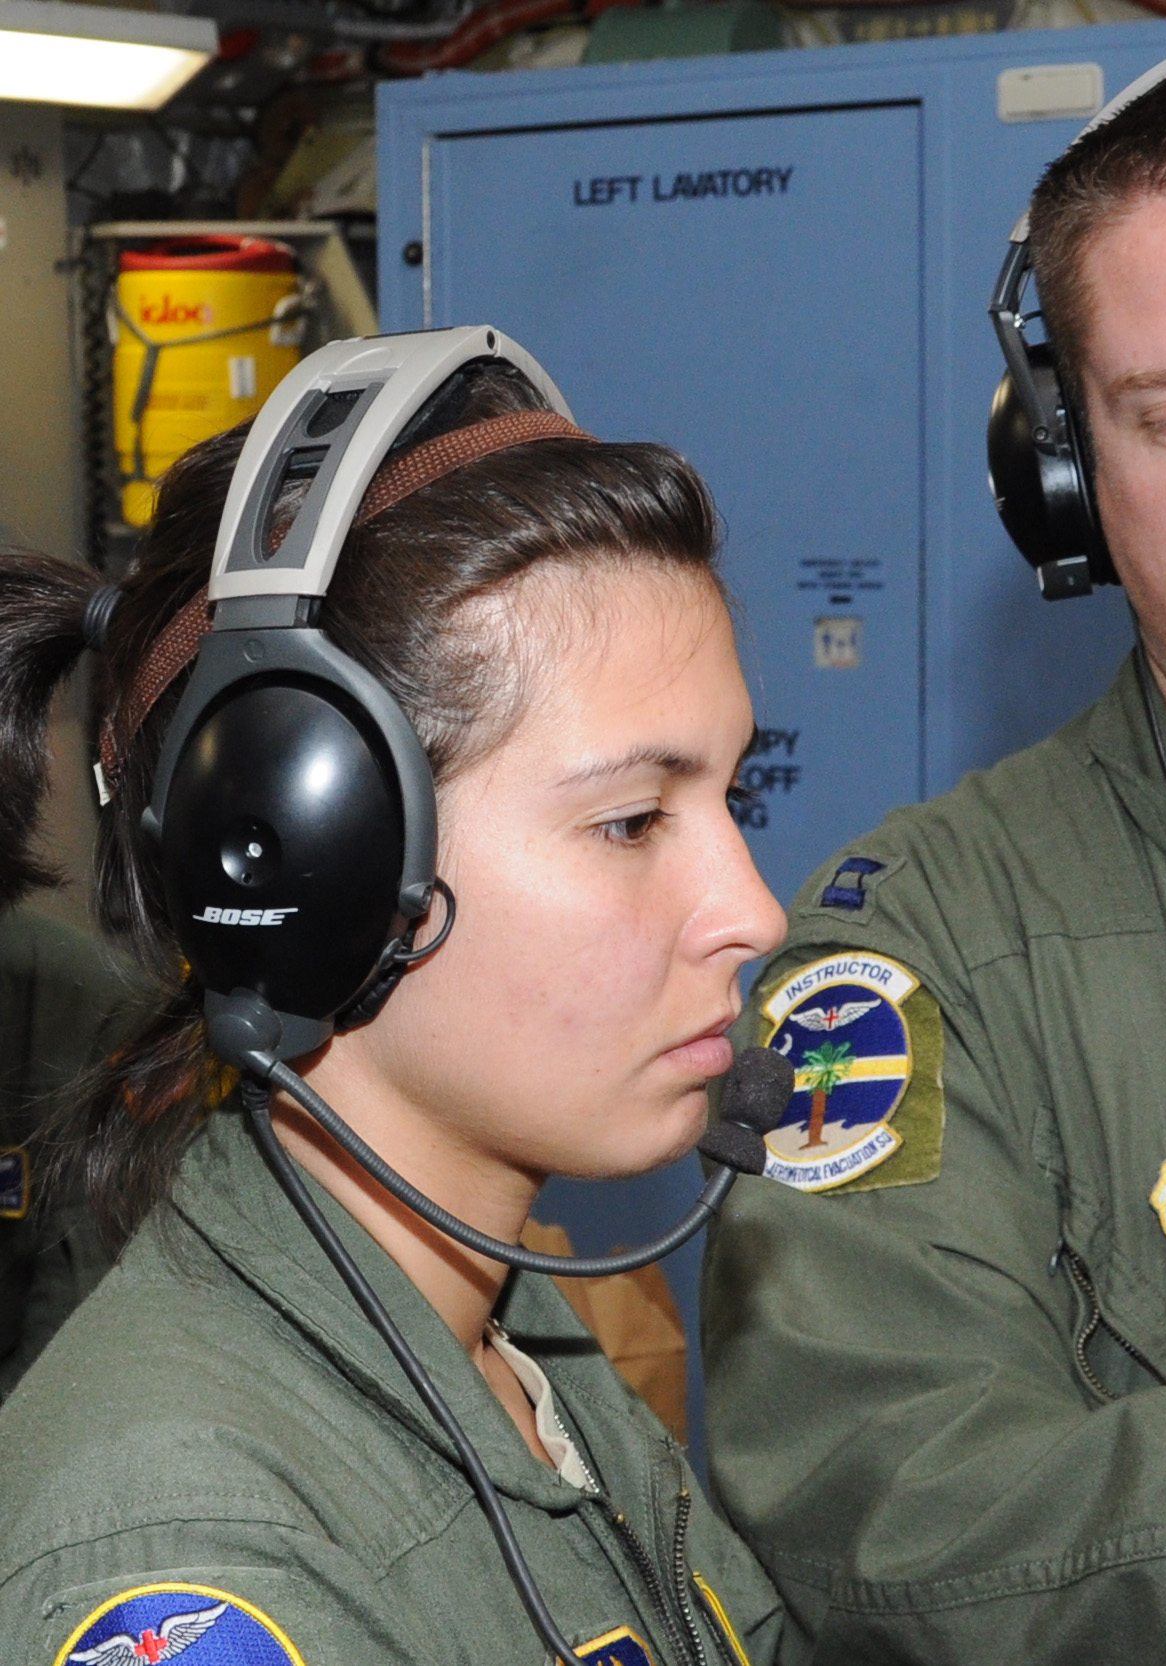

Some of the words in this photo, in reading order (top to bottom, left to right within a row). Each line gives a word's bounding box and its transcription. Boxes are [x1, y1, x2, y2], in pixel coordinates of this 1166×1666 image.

[573, 175, 642, 206] LEFT
[653, 166, 794, 203] LAVATORY
[192, 906, 298, 926] BOSE
[785, 961, 893, 1001] INSTRUCTOR
[823, 1141, 878, 1179] EVACUATION
